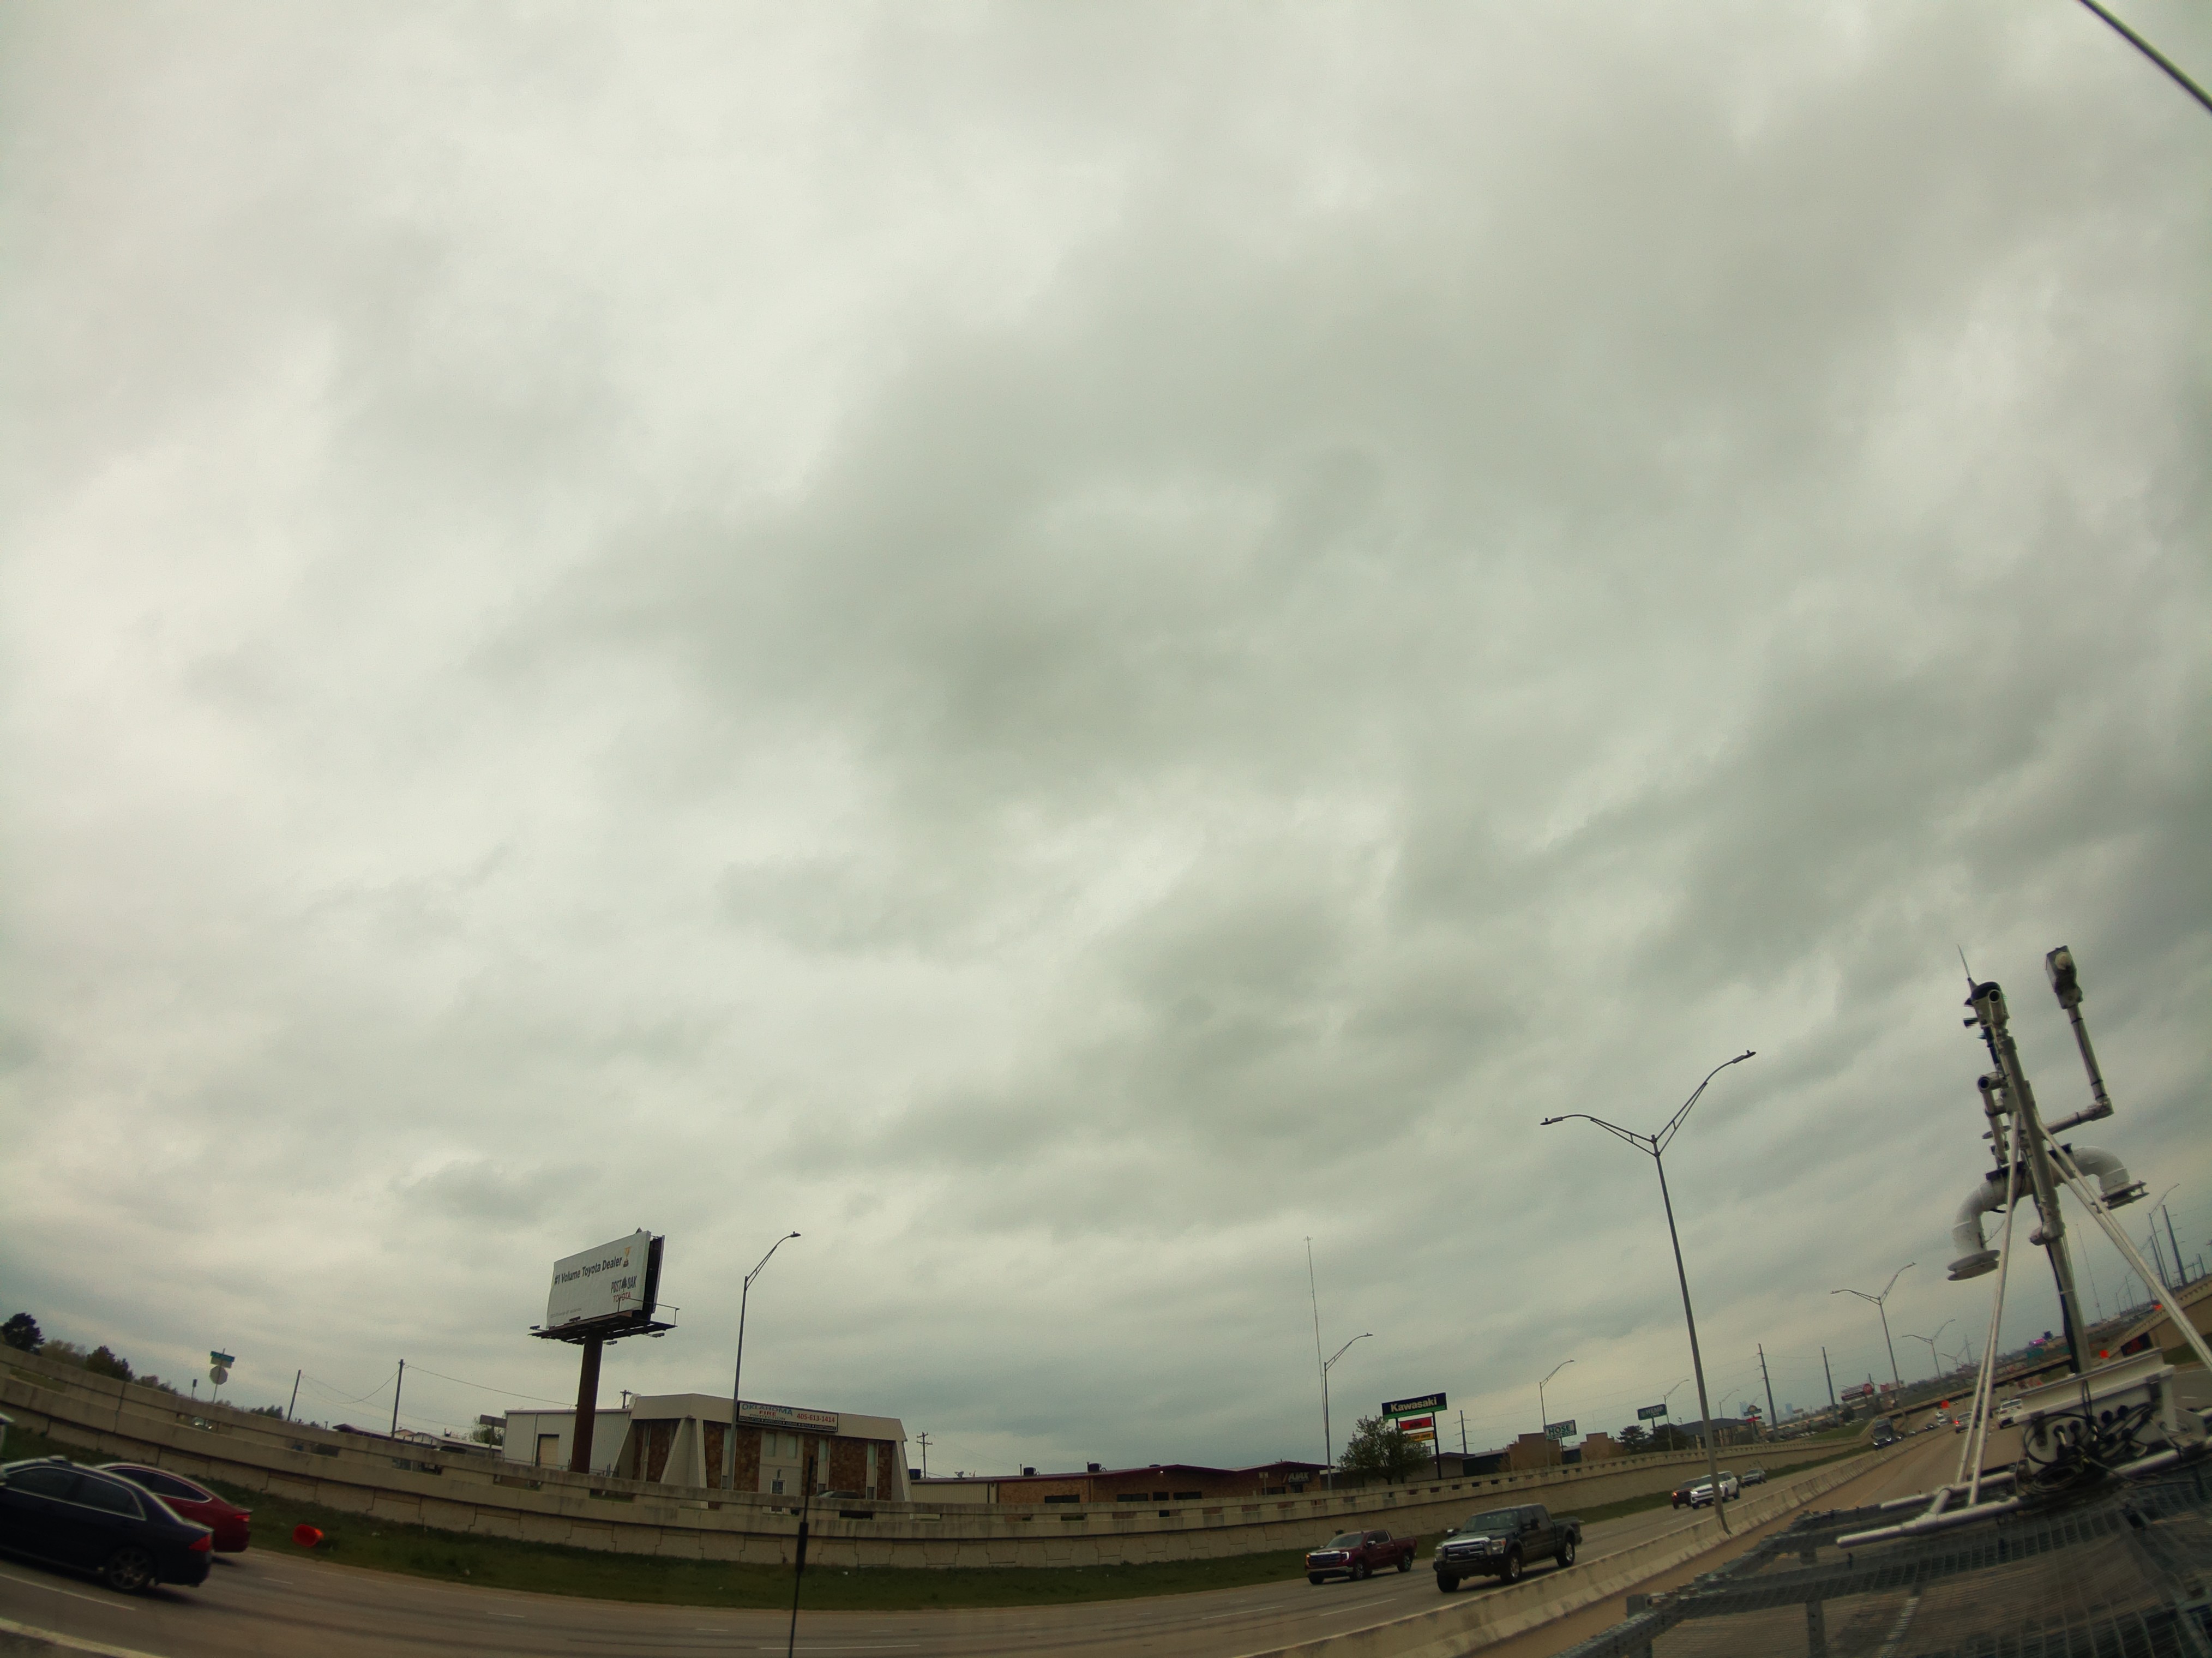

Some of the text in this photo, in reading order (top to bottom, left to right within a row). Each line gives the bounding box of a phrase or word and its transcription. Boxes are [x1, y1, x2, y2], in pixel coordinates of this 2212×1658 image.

[554, 1256, 622, 1285] #1 Volume Toyota Dealer
[611, 1276, 637, 1293] POST OAK
[613, 1291, 631, 1302] TOYOTA
[742, 1403, 793, 1416] OKLAHOMA
[1390, 1397, 1437, 1412] Kawasaki
[797, 1413, 835, 1423] 405-613-1414
[1549, 1425, 1571, 1434] HOSE
